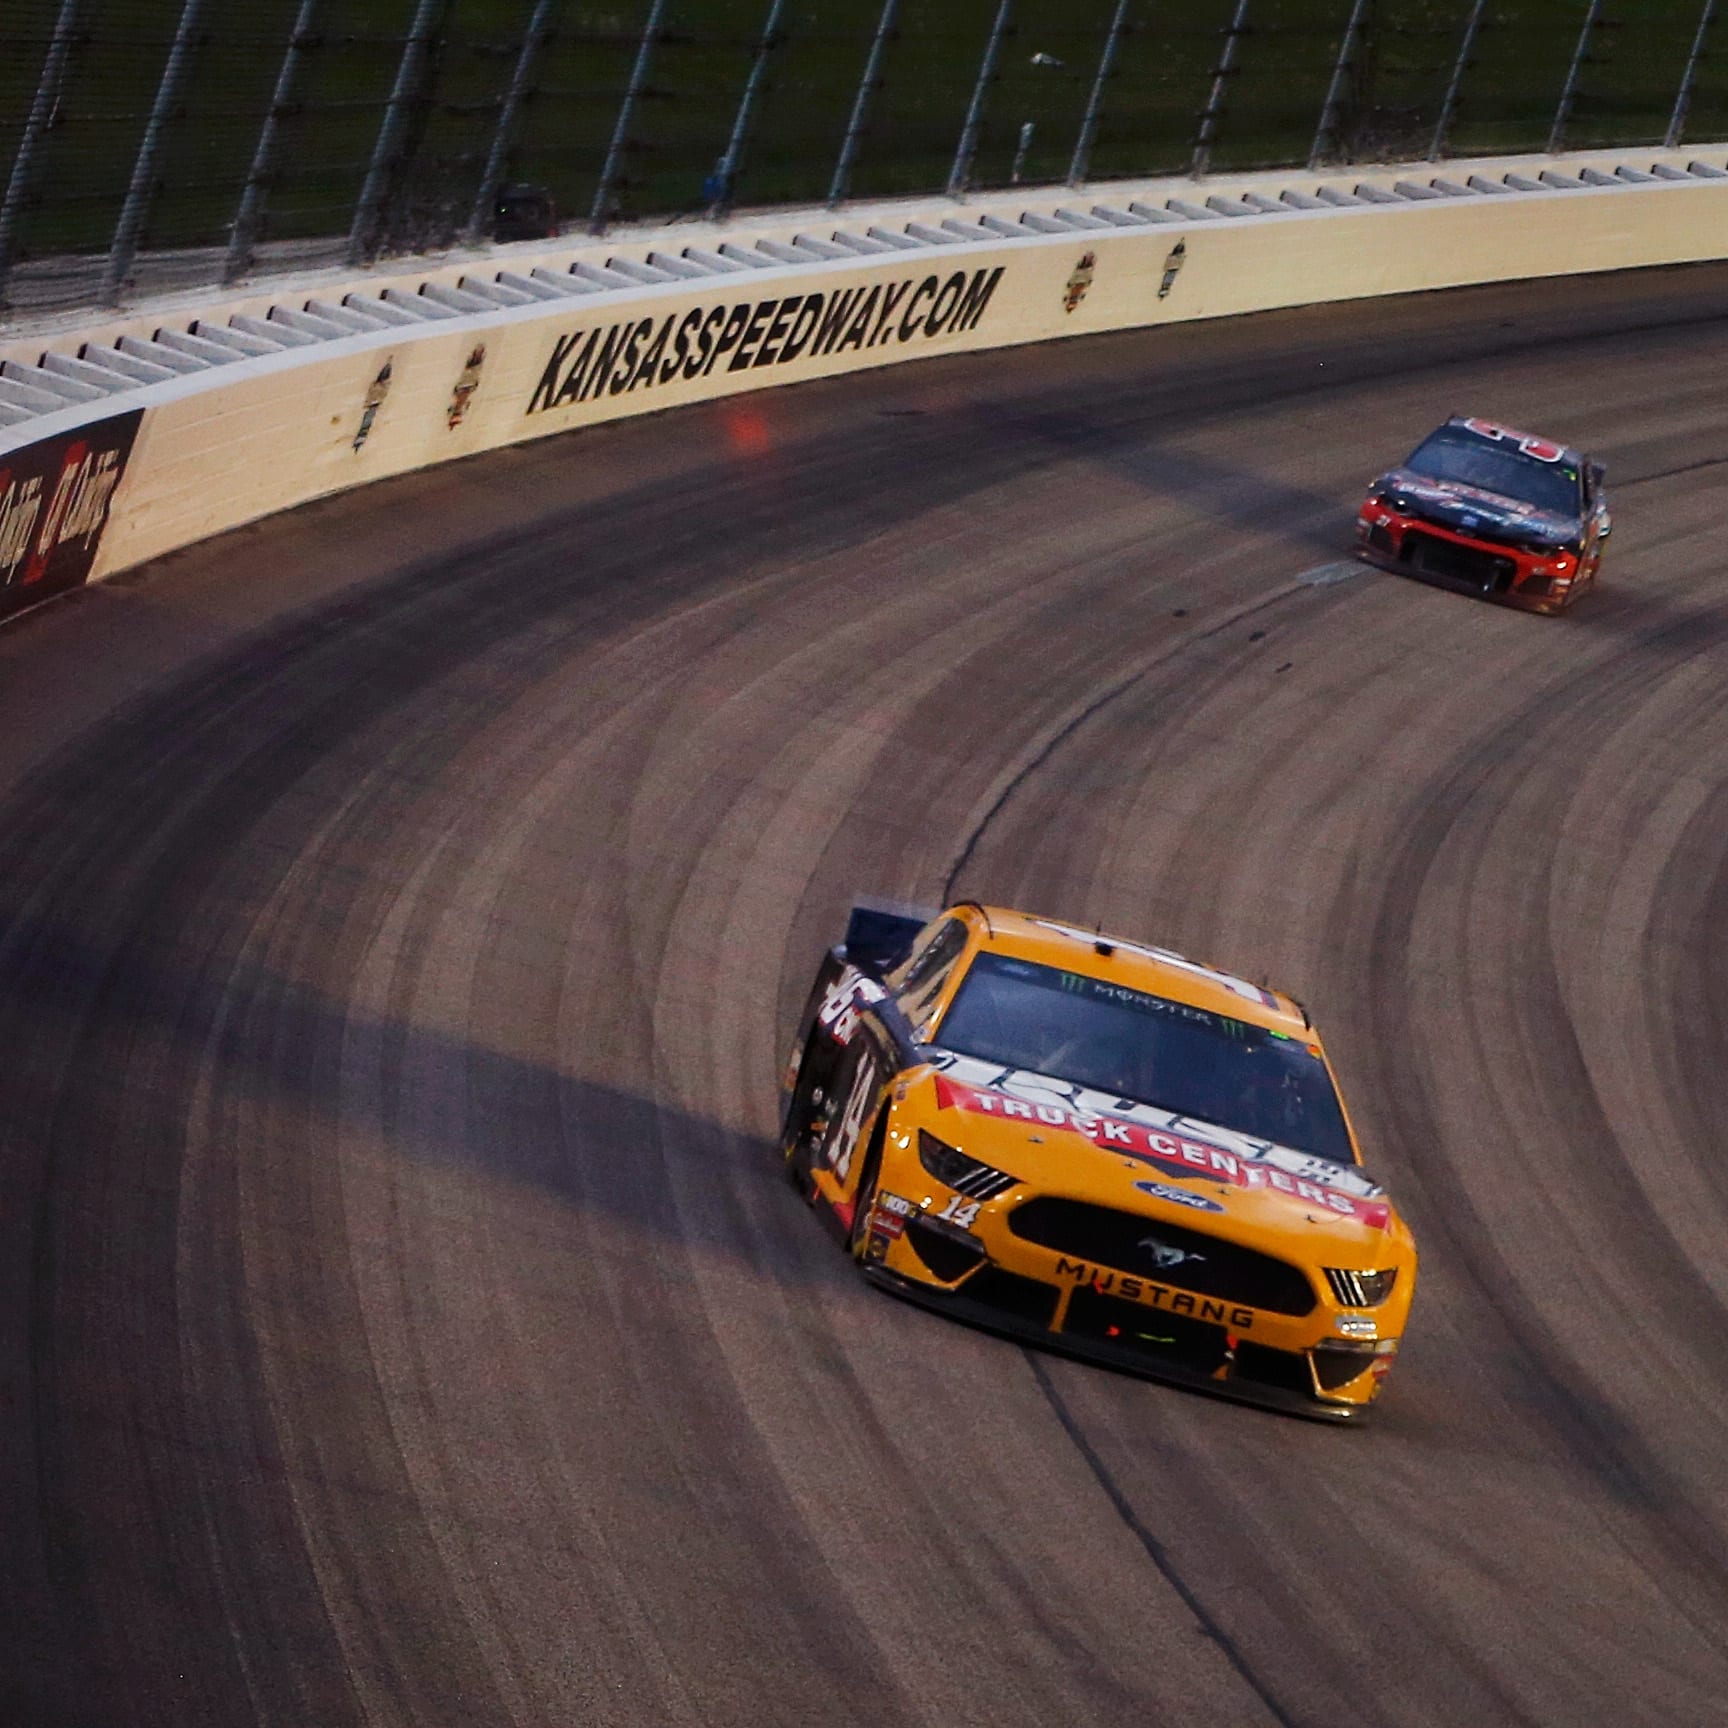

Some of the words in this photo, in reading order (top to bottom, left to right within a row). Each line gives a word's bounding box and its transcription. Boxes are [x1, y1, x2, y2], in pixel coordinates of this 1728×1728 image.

[526, 266, 1006, 415] KANSASSPEEDWAY.COM
[973, 1090, 1133, 1144] TRUCK
[1147, 1132, 1356, 1215] CENTERS
[937, 1194, 982, 1229] 14
[1150, 1183, 1210, 1208] Ford
[1056, 1257, 1255, 1329] MUSTANG
